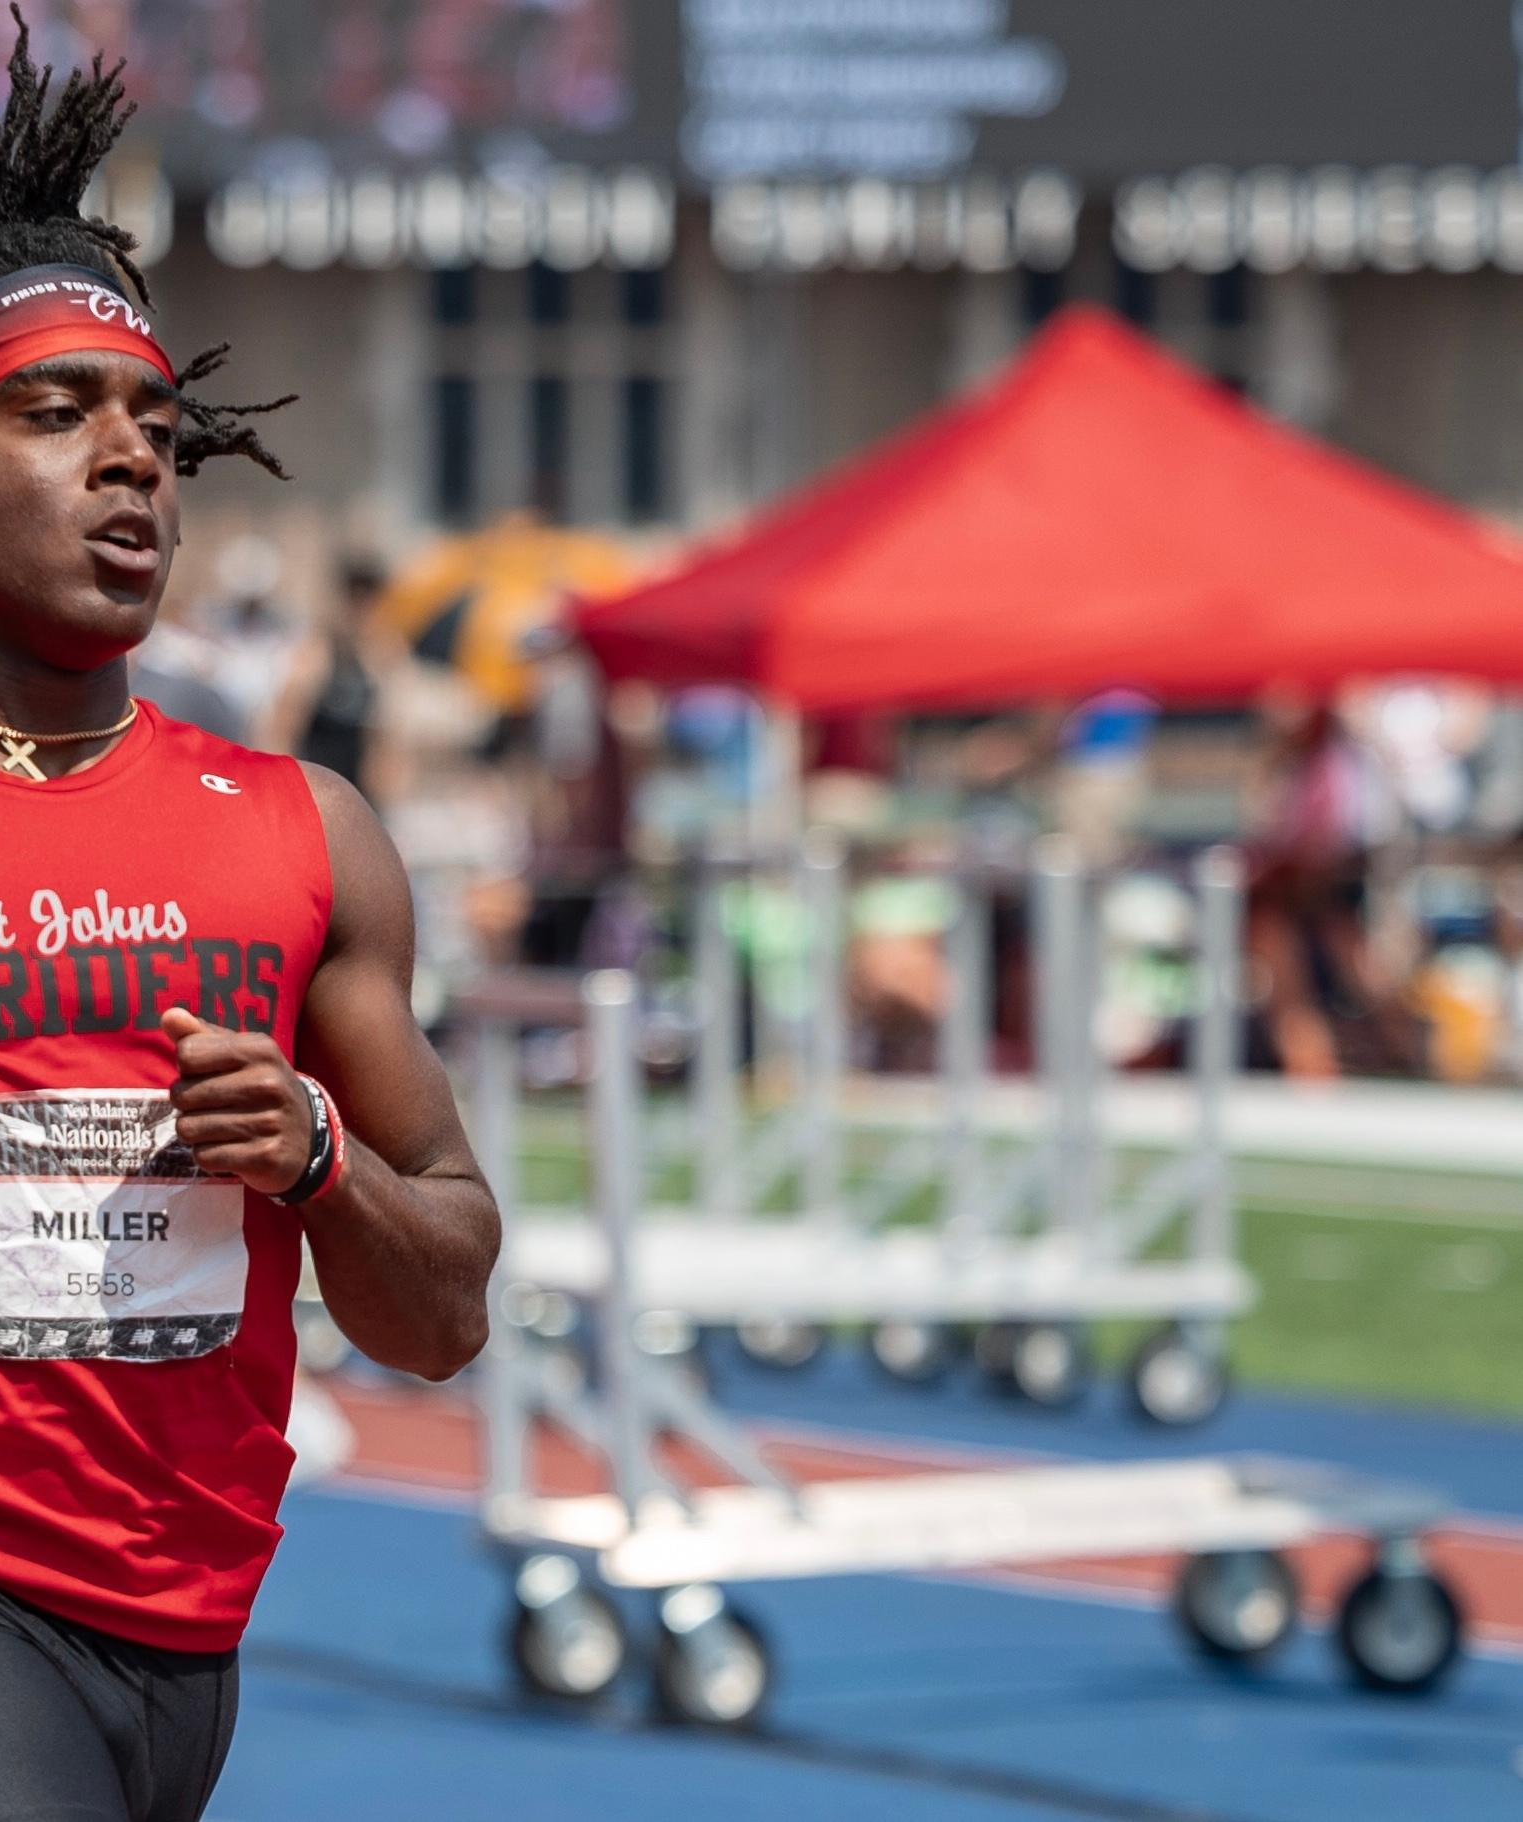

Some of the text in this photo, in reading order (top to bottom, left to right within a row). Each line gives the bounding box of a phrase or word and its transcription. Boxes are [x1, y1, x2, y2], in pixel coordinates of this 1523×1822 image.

[0, 281, 58, 308] FINISH
[29, 887, 189, 956] Johns
[63, 1103, 139, 1119] New Balance
[51, 1122, 152, 1149] Nationals
[32, 1210, 170, 1242] MILLER
[66, 1272, 136, 1297] 5558
